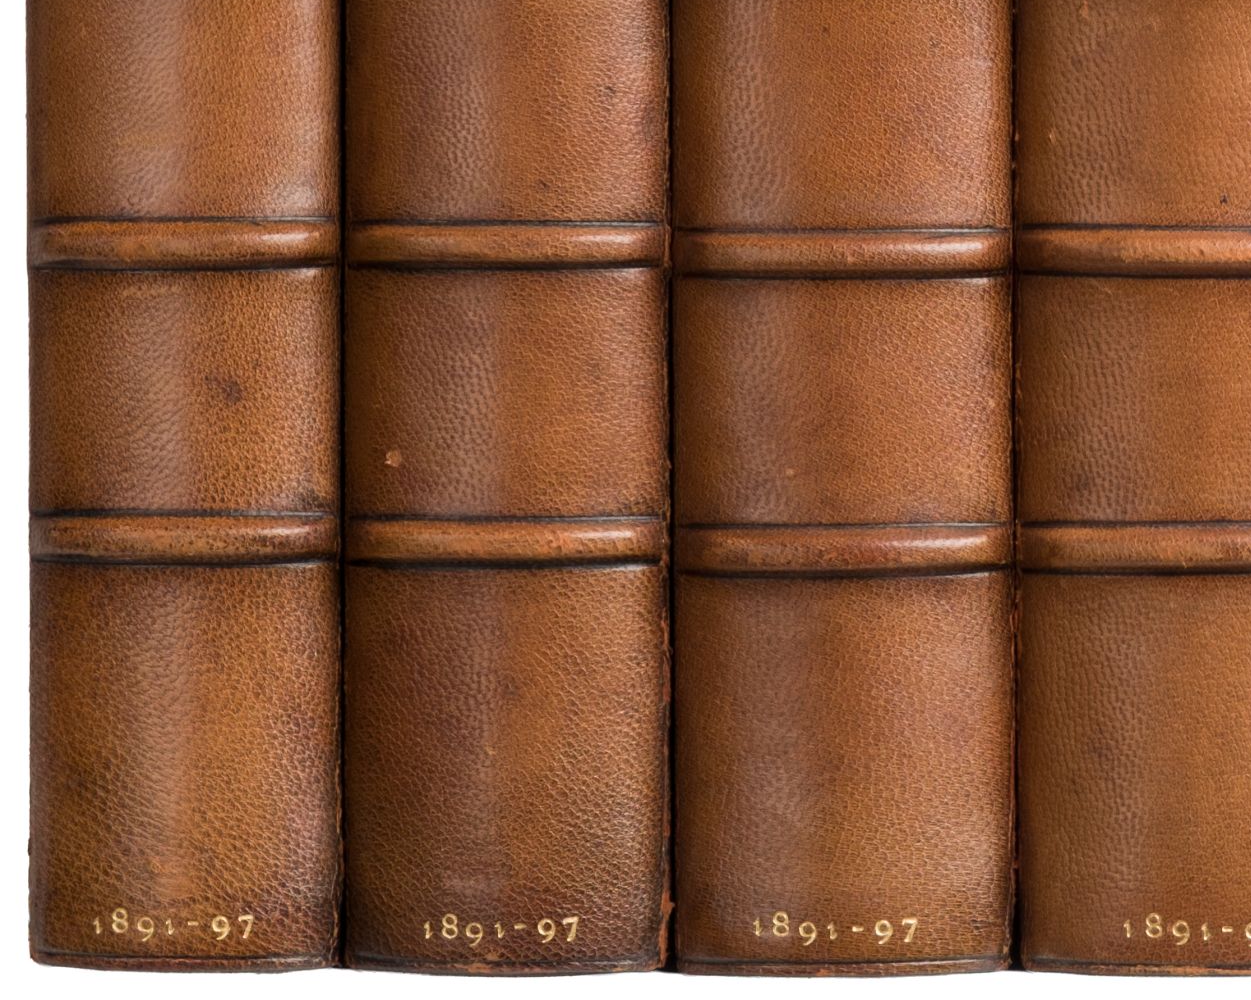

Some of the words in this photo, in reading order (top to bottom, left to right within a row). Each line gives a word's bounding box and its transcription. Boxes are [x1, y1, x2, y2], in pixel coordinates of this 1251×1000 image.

[92, 907, 255, 942] 1891-97
[423, 915, 581, 948] 1891-97
[752, 911, 919, 946] 1891-97
